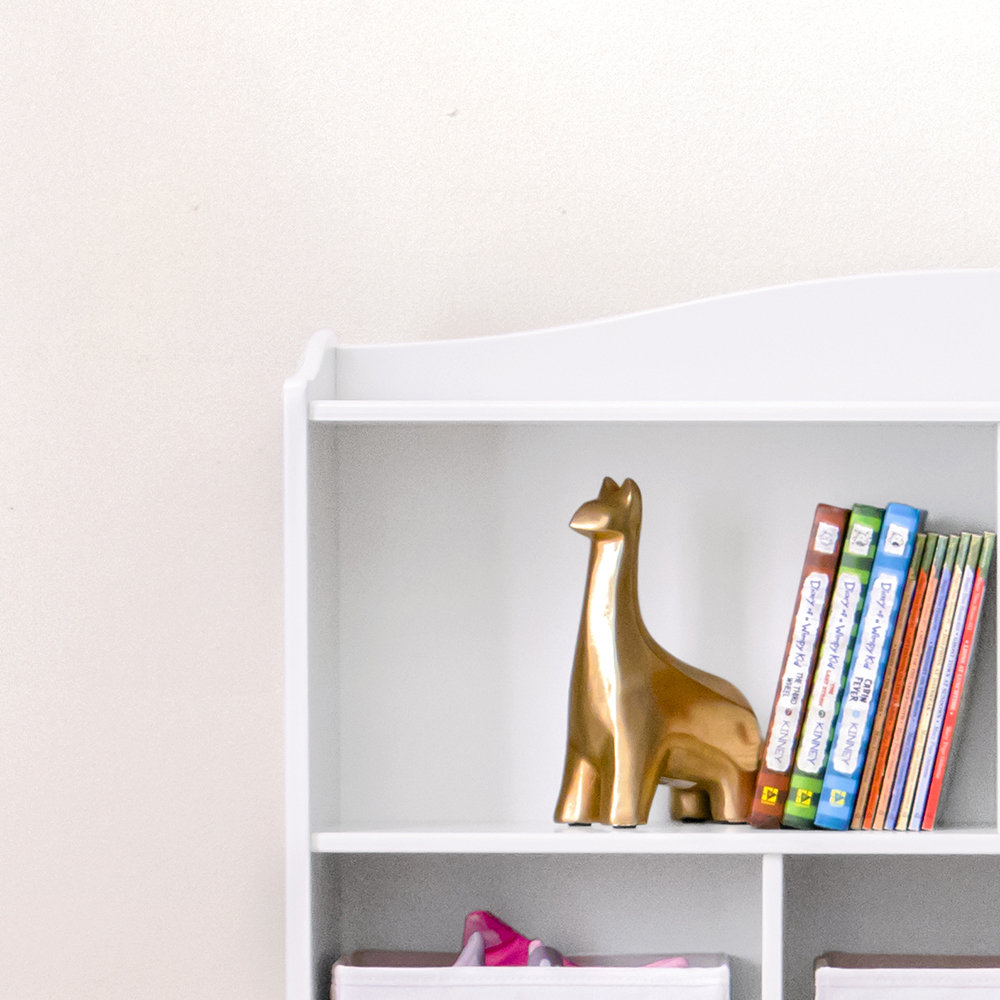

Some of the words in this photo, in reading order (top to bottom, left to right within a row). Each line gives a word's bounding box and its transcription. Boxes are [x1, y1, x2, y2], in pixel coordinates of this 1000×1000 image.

[806, 580, 821, 605] Diary
[841, 582, 856, 608] Diary
[876, 582, 892, 609] Diary
[796, 624, 811, 651] Wimpy
[830, 625, 845, 653] Wimpy
[865, 626, 881, 654] Wimpy
[794, 653, 805, 667] Kid
[827, 655, 840, 669] Kid
[864, 655, 875, 670] Kid
[783, 678, 793, 696] WHEEL
[794, 673, 803, 684] THE
[850, 677, 864, 702] FEVER
[860, 679, 872, 703] CABIN
[774, 720, 790, 764] KINNEY
[808, 722, 824, 766] KINNEY
[842, 722, 859, 766] KINNEY
